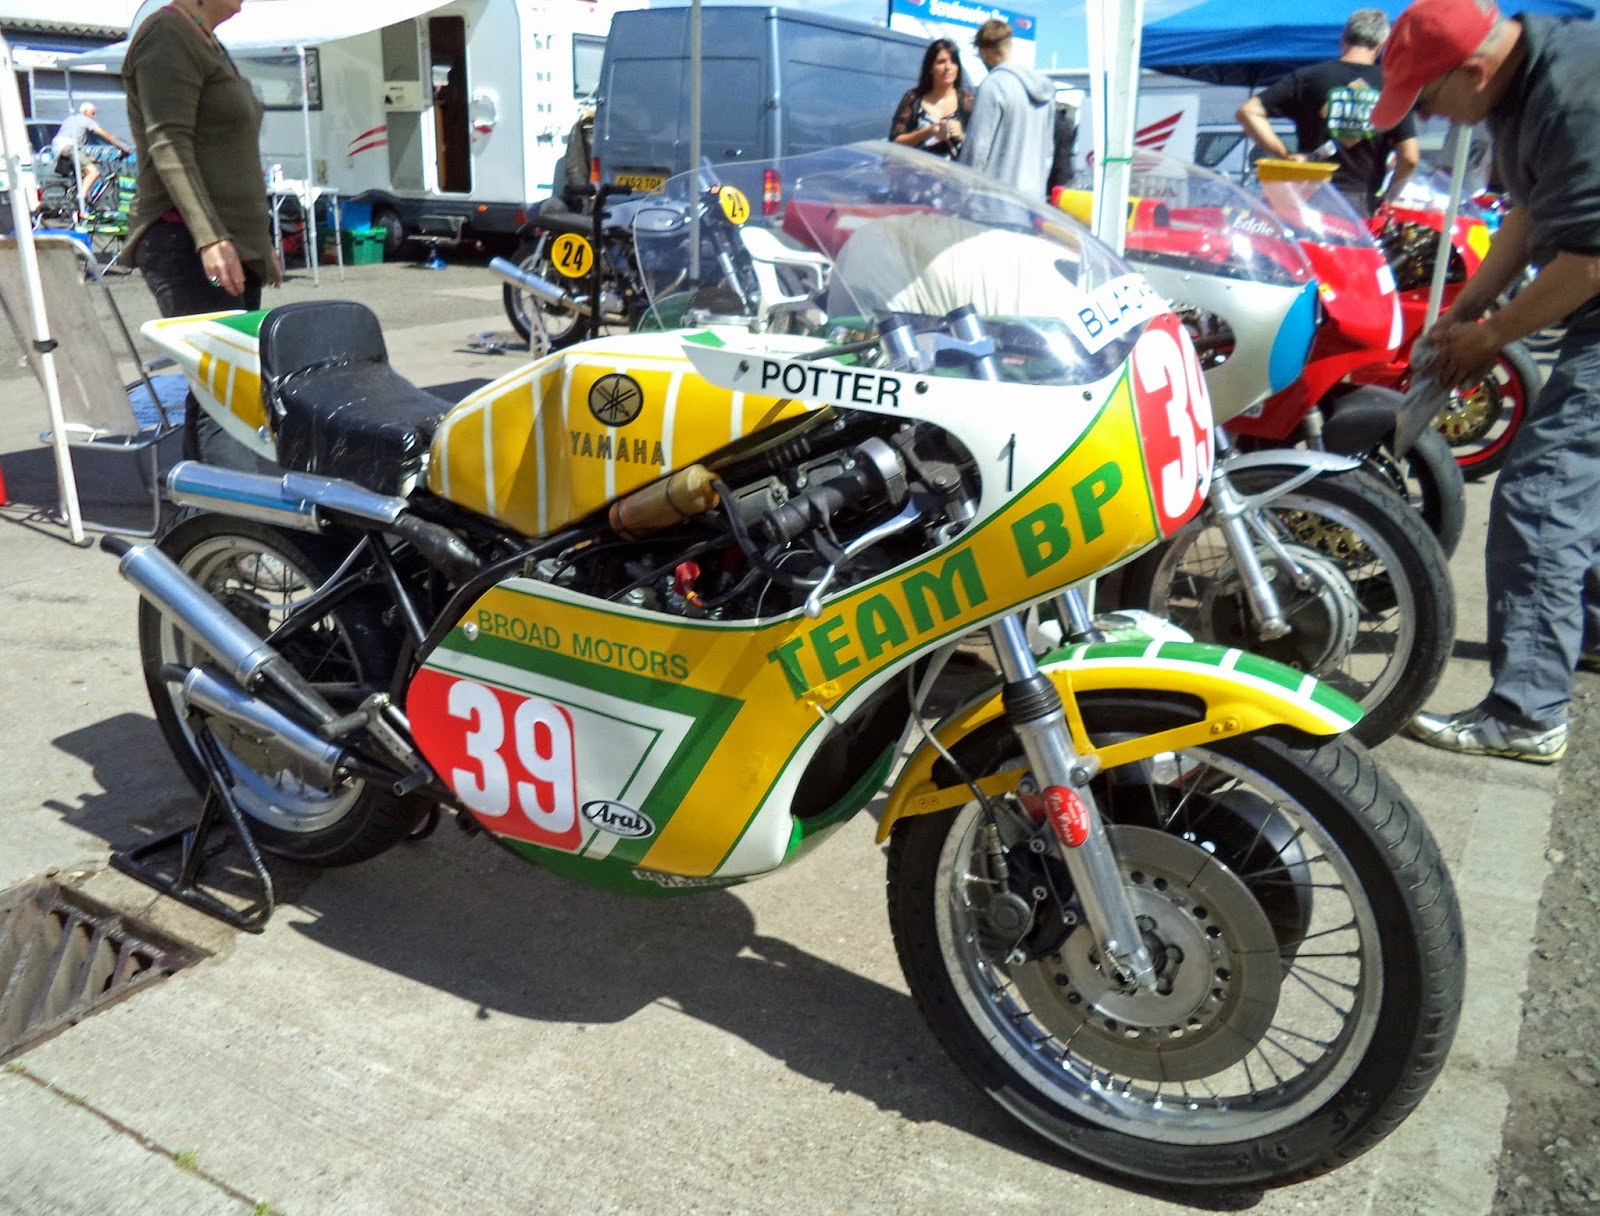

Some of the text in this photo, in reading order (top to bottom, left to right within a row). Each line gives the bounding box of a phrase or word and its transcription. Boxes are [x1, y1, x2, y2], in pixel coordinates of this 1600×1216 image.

[1232, 215, 1275, 236] Eddie
[561, 241, 585, 271] 24
[761, 360, 902, 408] POTTER
[1134, 328, 1215, 518] 39
[569, 431, 666, 466] YAMAHA
[768, 461, 1123, 700] TEAM BP
[477, 609, 690, 680] BROAD MOTORS
[448, 680, 576, 835] 39
[587, 803, 644, 830] Arai
